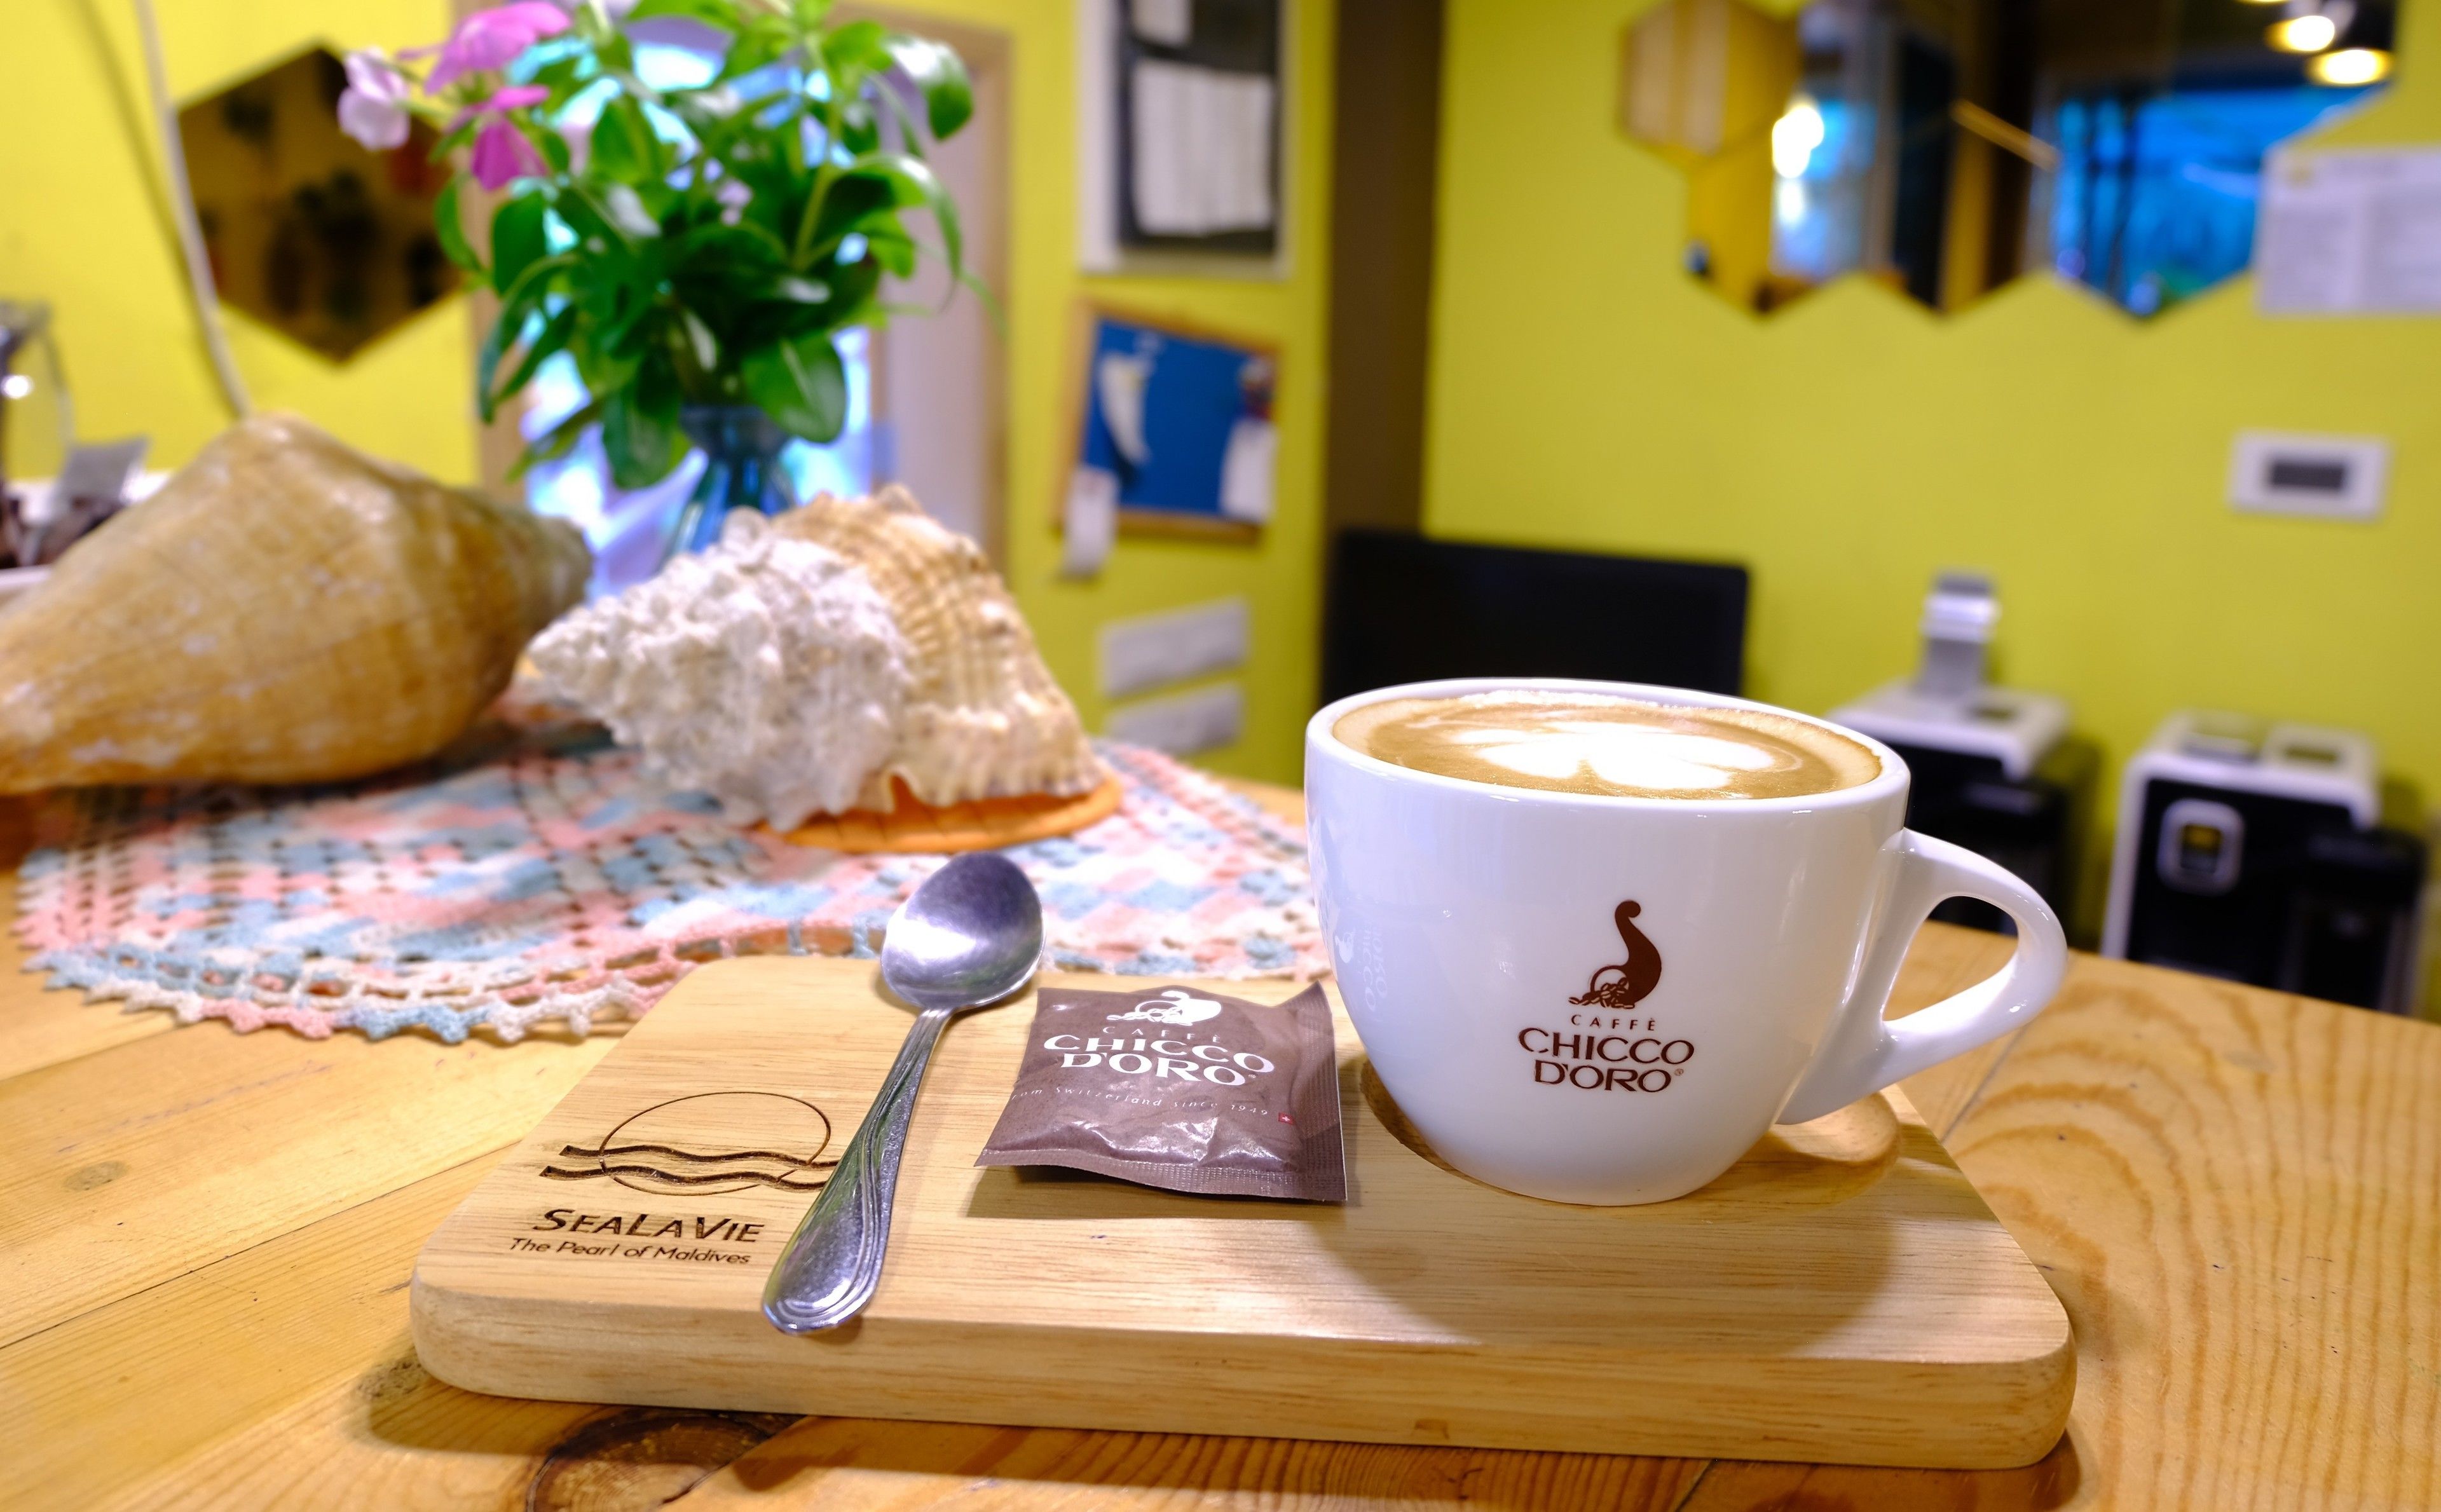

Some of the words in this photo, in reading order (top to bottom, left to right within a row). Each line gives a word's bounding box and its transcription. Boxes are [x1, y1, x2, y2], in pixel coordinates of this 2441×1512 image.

[1103, 1026, 1220, 1043] CAFFÈ
[1571, 1014, 1656, 1031] CAFFÈ
[1044, 1035, 1274, 1072] CHICCO
[1518, 1028, 1694, 1065] CHICCO
[1011, 1089, 1043, 1101] rom
[1056, 1087, 1162, 1106] Switzerland
[1231, 1104, 1268, 1115] 1949
[509, 1237, 550, 1253] The
[557, 1241, 620, 1256] Pearl
[624, 1244, 650, 1258] of
[653, 1246, 751, 1264] Maldives
